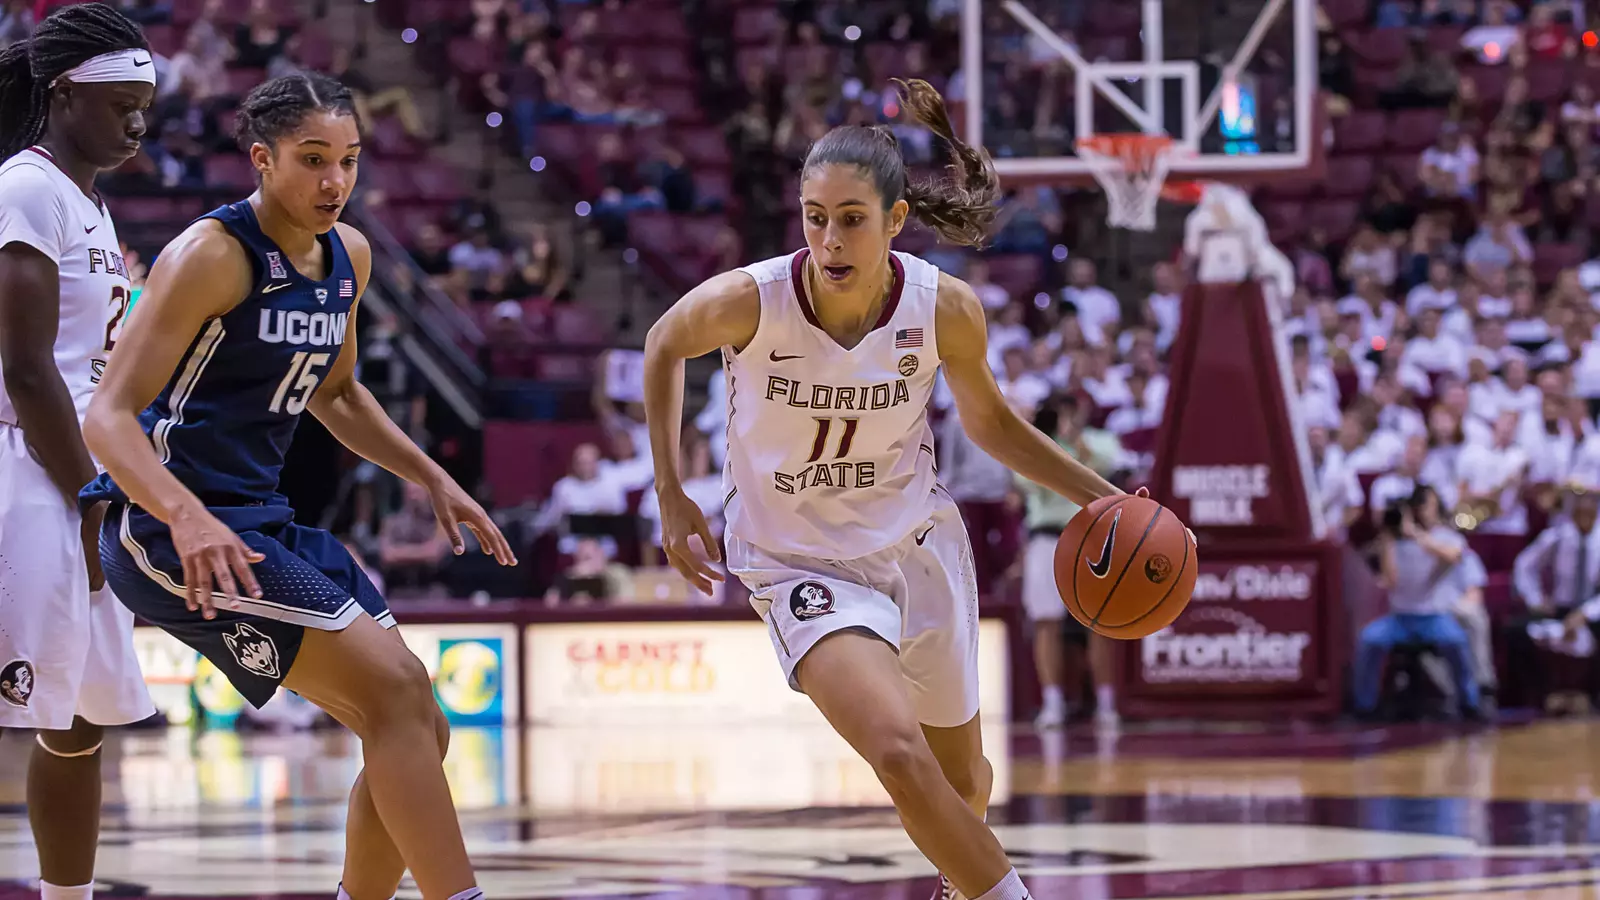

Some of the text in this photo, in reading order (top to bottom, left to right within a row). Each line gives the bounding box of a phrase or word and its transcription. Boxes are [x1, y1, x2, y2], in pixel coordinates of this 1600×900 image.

[268, 351, 331, 415] 15
[765, 376, 910, 411] FLORIDA
[805, 416, 860, 464] 11
[774, 461, 876, 495] STATE
[1142, 626, 1310, 668] Frontier
